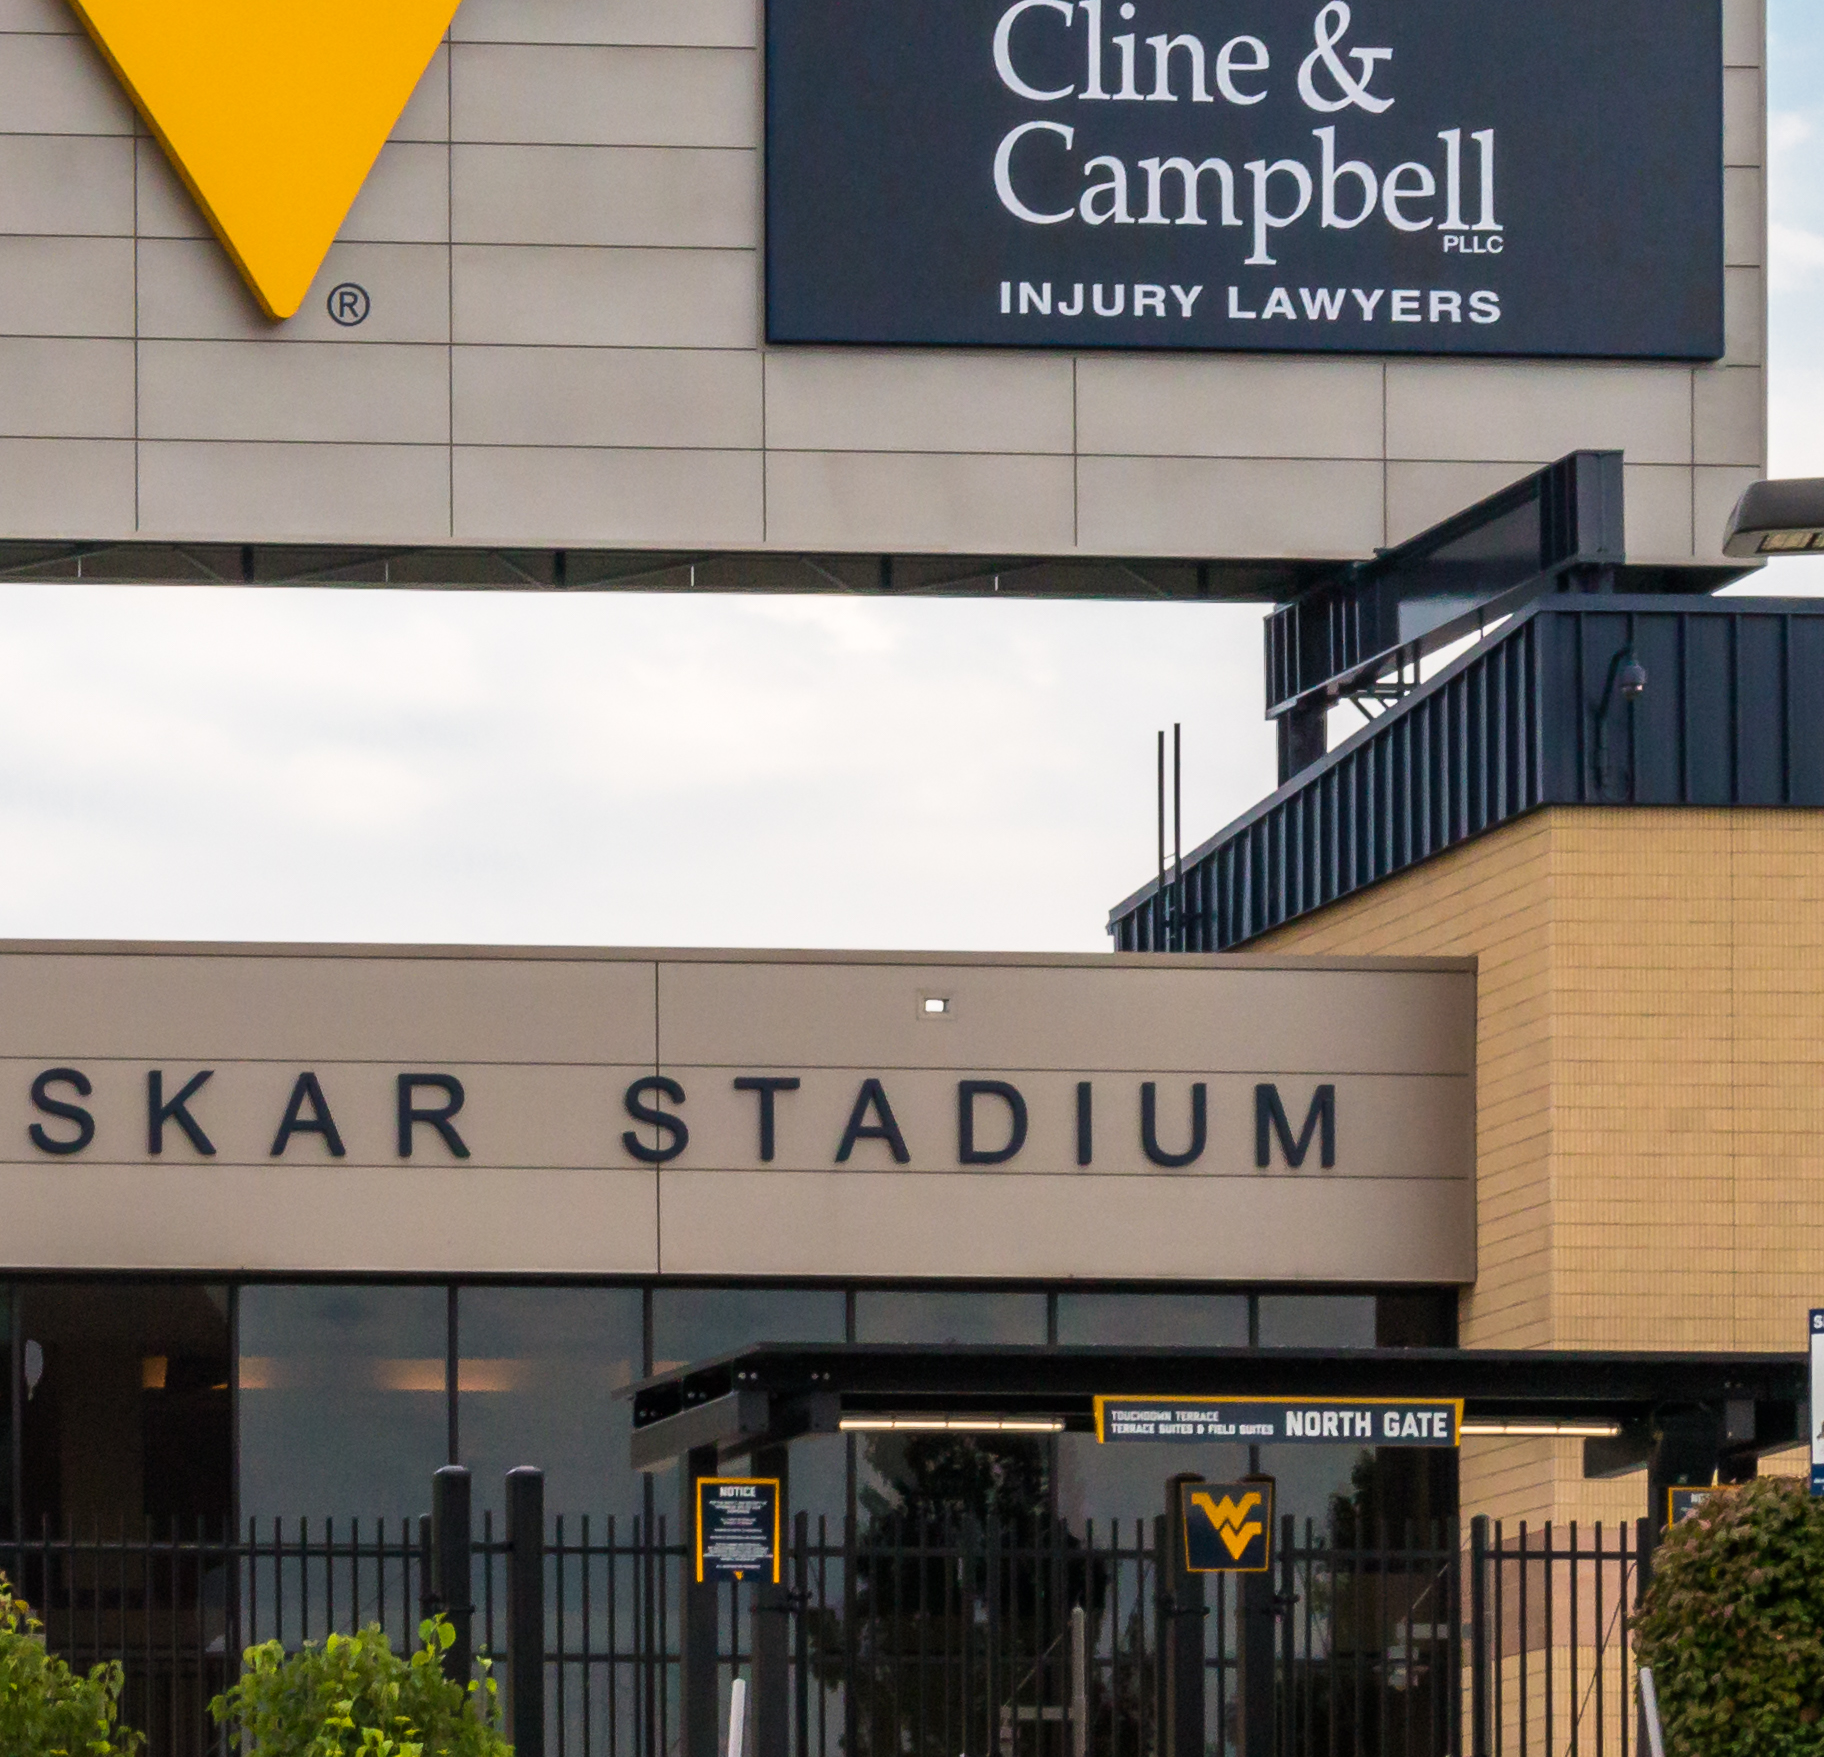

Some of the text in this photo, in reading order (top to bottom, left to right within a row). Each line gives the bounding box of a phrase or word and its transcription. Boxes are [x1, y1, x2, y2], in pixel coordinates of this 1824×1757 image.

[1297, 0, 1396, 114] &
[993, 120, 1504, 266] Campbell
[1442, 234, 1504, 254] PLLC
[1000, 281, 1501, 324] INJURY LAWYERS
[621, 1075, 1337, 1170] STADIUM
[1111, 1410, 1219, 1423] TOUCHDOWN TERRACE
[1111, 1423, 1155, 1434] TERRACE
[1159, 1423, 1194, 1435] SUITES
[1208, 1424, 1236, 1435] FIELD
[1239, 1424, 1274, 1436] SUITES
[1285, 1410, 1448, 1438] NORTH GATE
[719, 1486, 756, 1498] NOTICE
